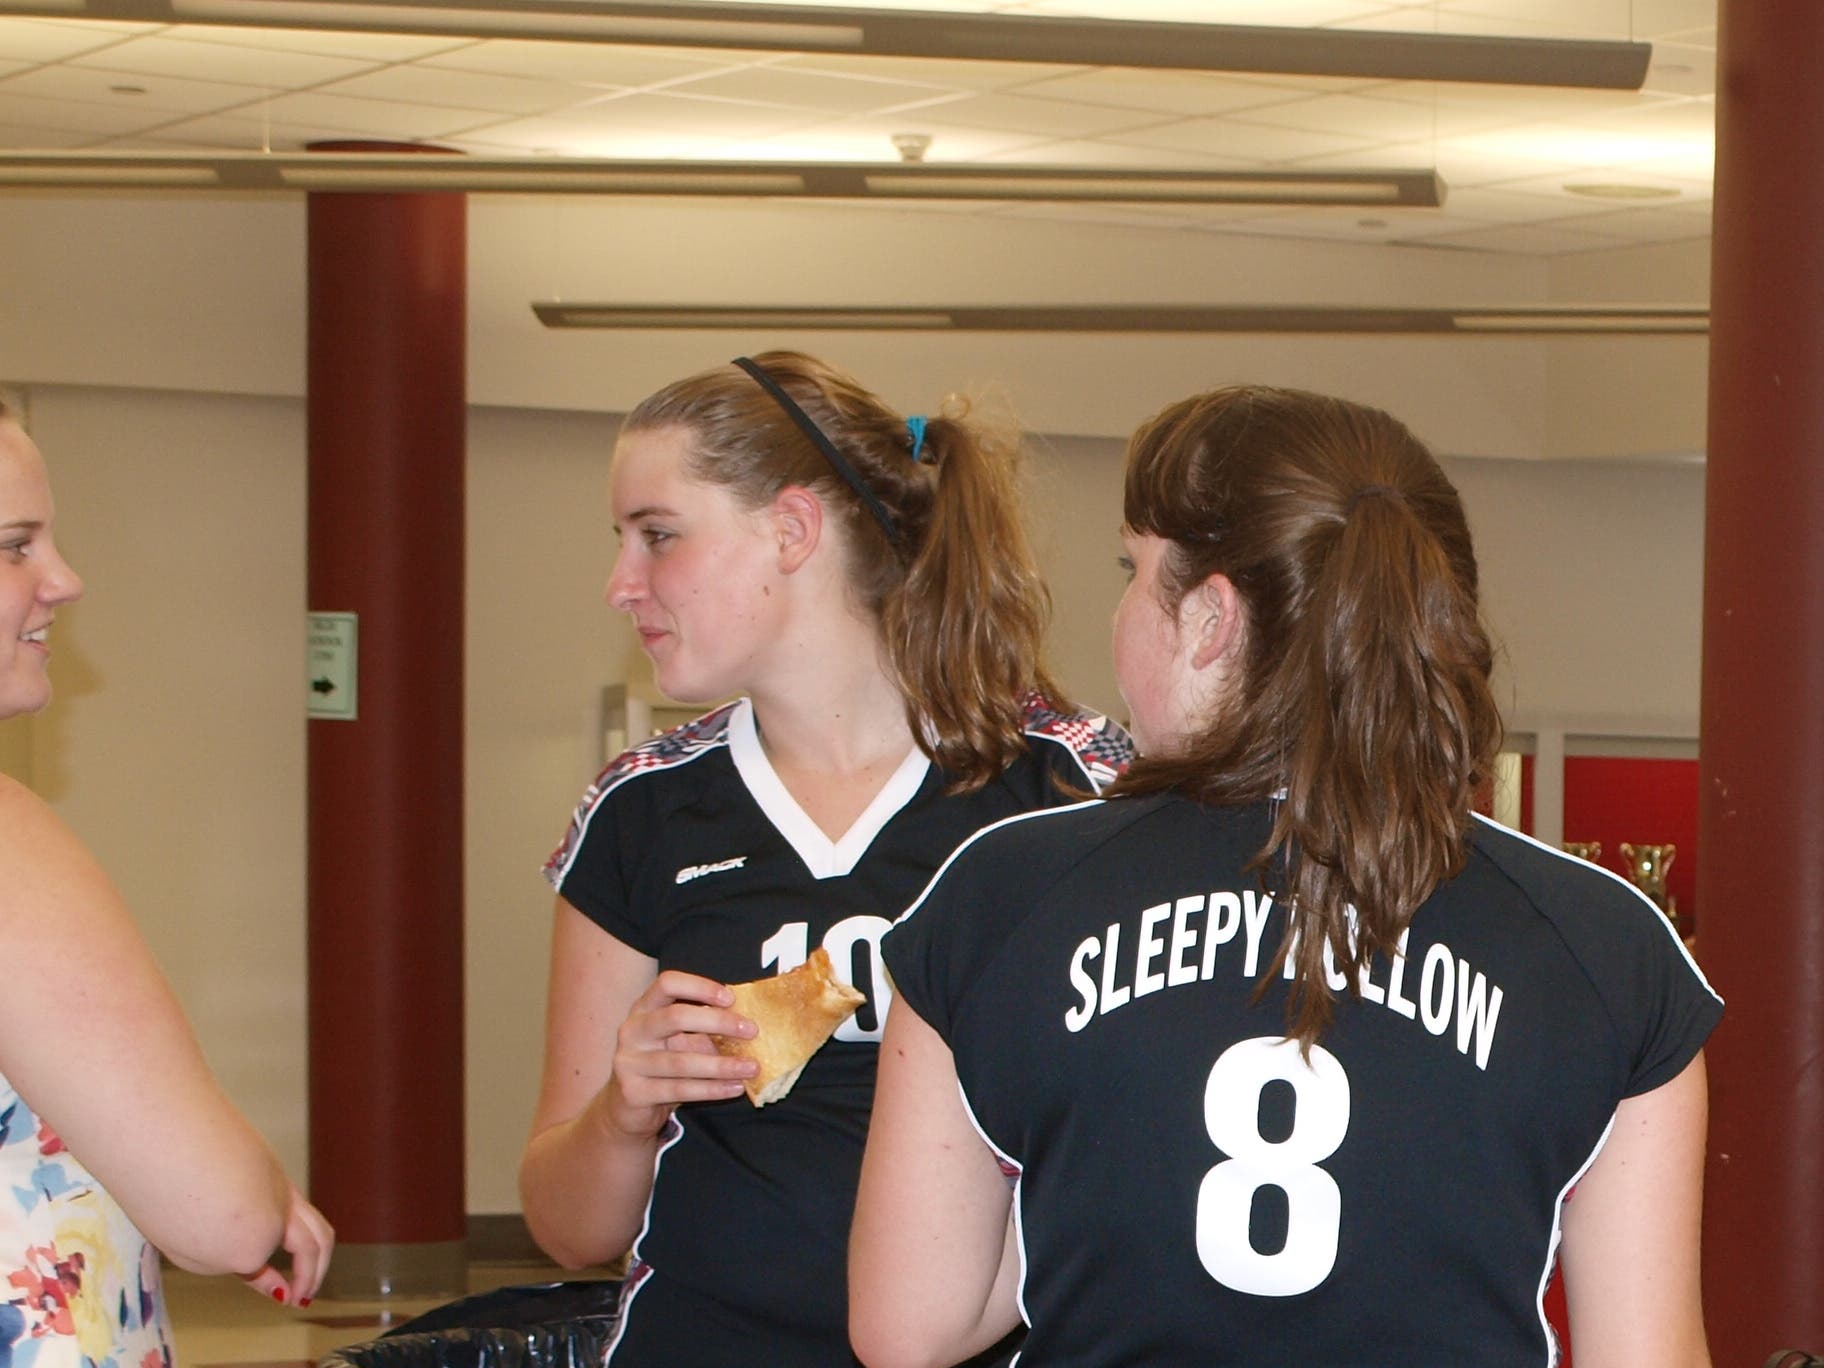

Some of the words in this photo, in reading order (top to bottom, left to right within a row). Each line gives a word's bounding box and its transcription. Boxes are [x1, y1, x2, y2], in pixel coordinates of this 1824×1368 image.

[1065, 890, 1275, 1033] SLEEPY
[1282, 893, 1504, 1071] LLOW
[1196, 1035, 1351, 1297] 8
